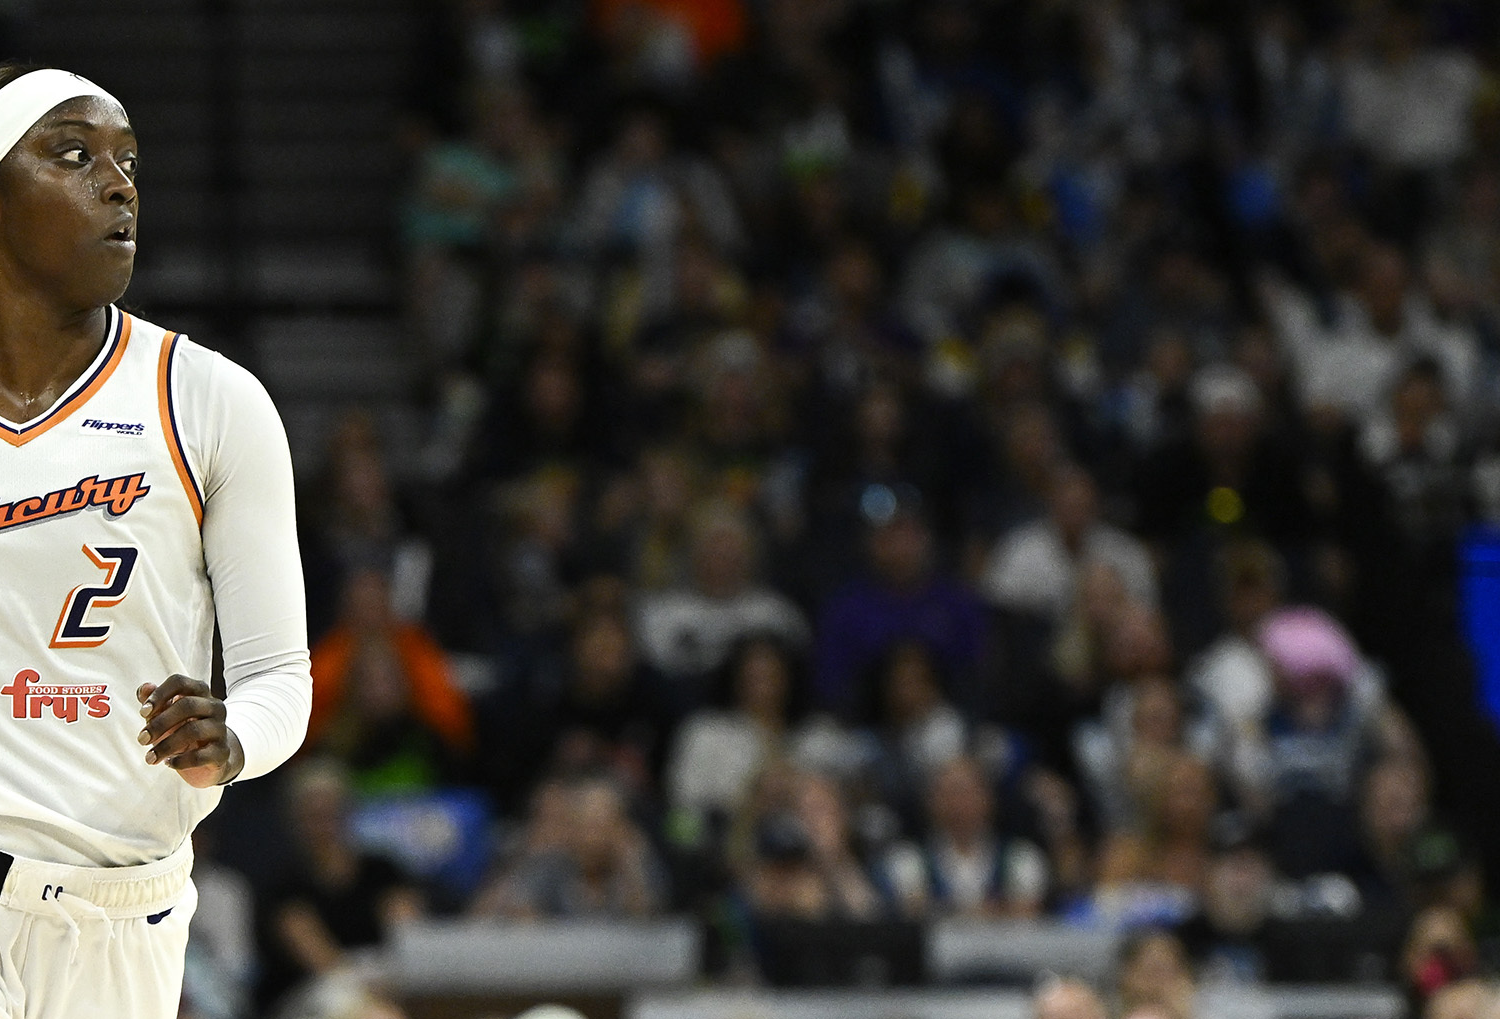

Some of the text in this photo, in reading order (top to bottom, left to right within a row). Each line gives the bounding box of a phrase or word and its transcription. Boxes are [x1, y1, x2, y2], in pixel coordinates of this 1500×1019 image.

[49, 544, 139, 649] 2
[0, 668, 111, 723] fry's
[29, 685, 103, 694] FOOD STORES
